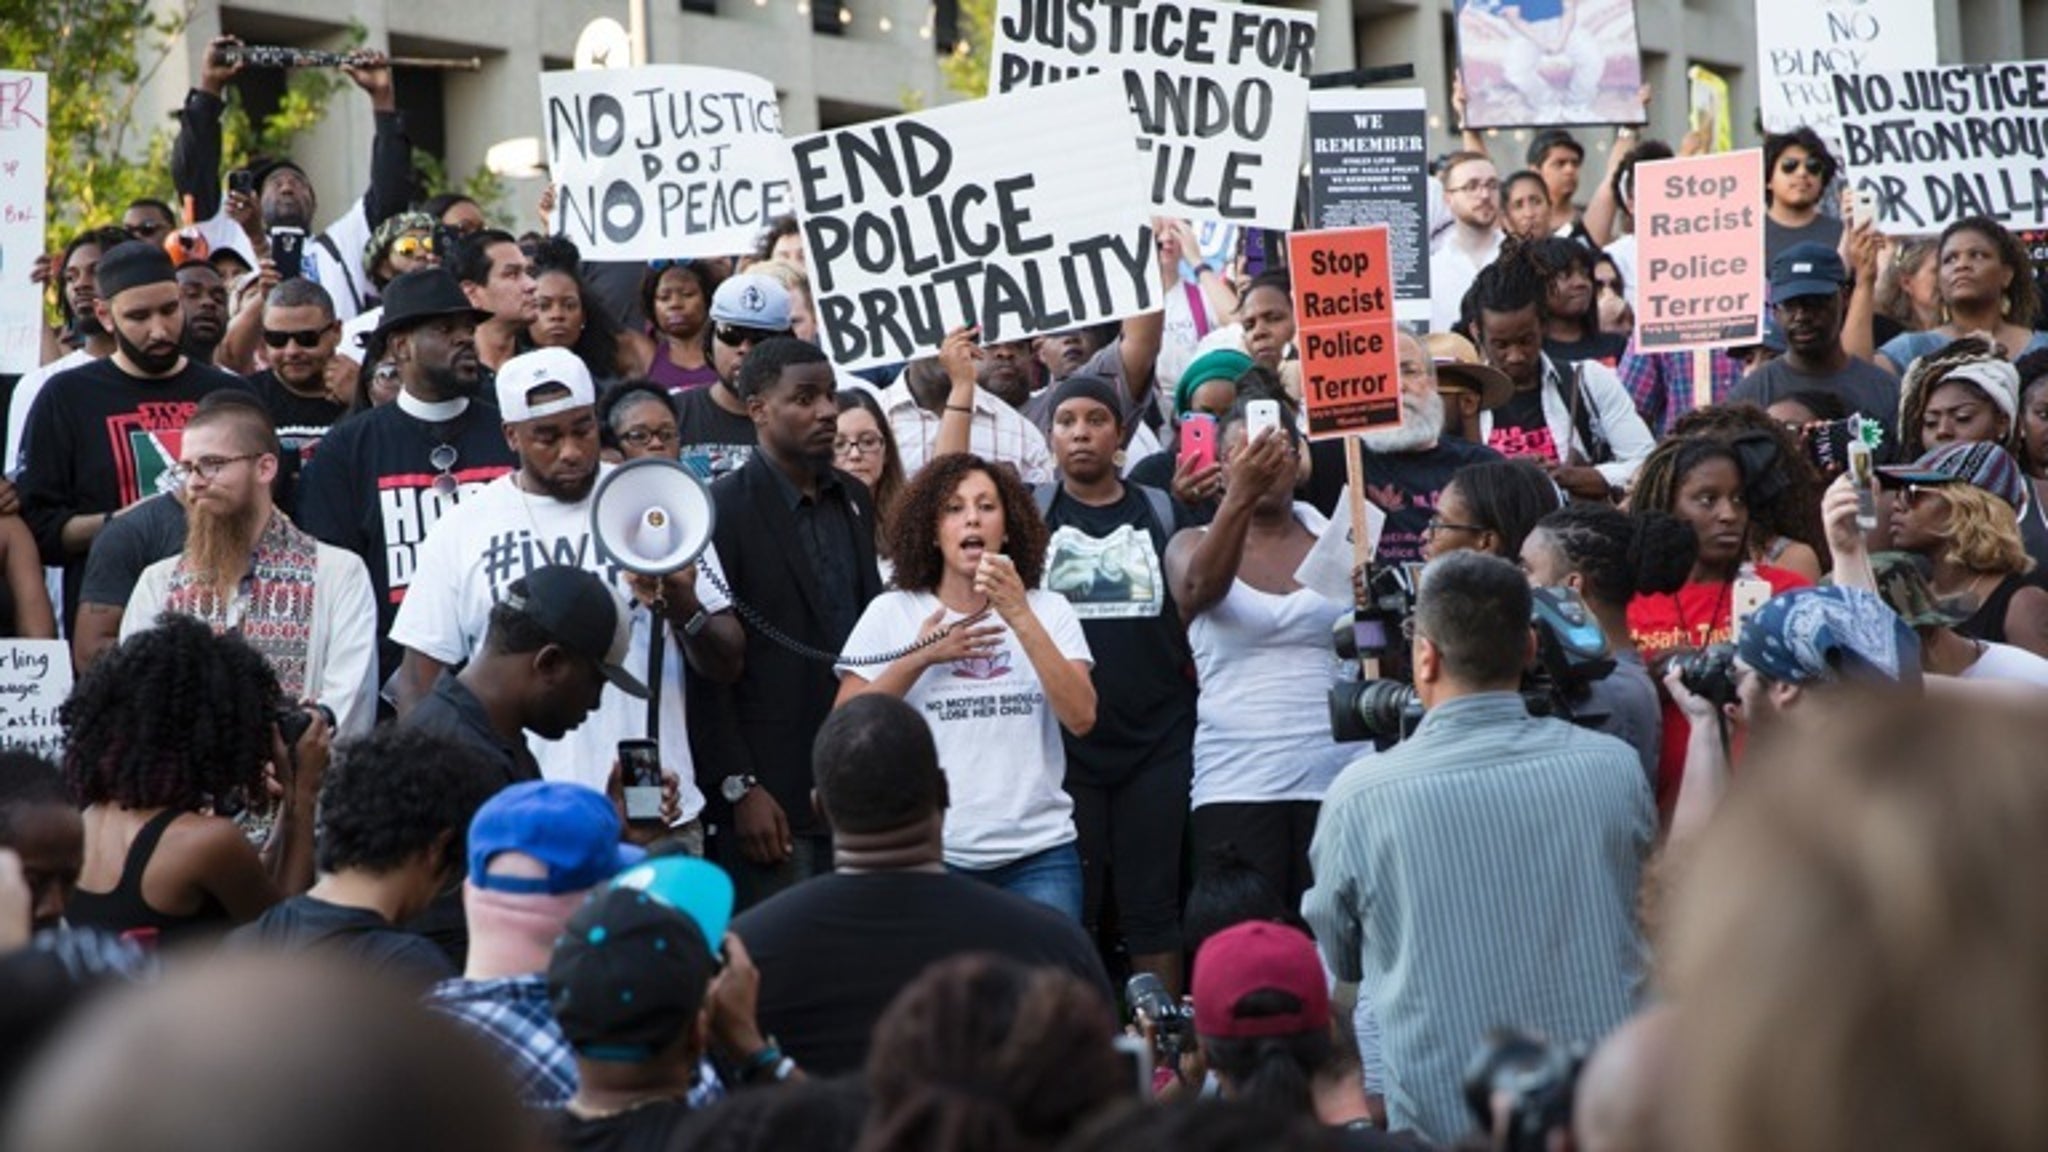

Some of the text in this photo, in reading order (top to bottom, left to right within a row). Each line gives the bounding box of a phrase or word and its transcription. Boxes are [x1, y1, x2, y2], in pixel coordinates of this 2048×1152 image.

[1827, 12, 1879, 43] NO
[1228, 12, 1315, 77] FOR
[1832, 64, 2048, 117] NO JUSTICE
[549, 88, 784, 162] NO JUSTICE
[1353, 114, 1382, 129] WE
[1314, 136, 1424, 153] REMEMBER
[792, 120, 952, 213] END
[1665, 174, 1738, 199] Stop
[560, 178, 793, 246] NO PEACE
[1650, 206, 1754, 238] Racist
[804, 173, 1054, 292] POLICE
[1311, 250, 1369, 278] Stop
[1650, 255, 1748, 282] Police
[818, 225, 1152, 365] BRUTALITY
[1304, 286, 1385, 318] Racist
[1648, 292, 1749, 318] Terror
[1307, 332, 1384, 361] Police
[1310, 373, 1388, 401] Terror
[925, 693, 1043, 711] NO MOTHER SHOULD
[939, 705, 1033, 721] LOSE HER CHILD
